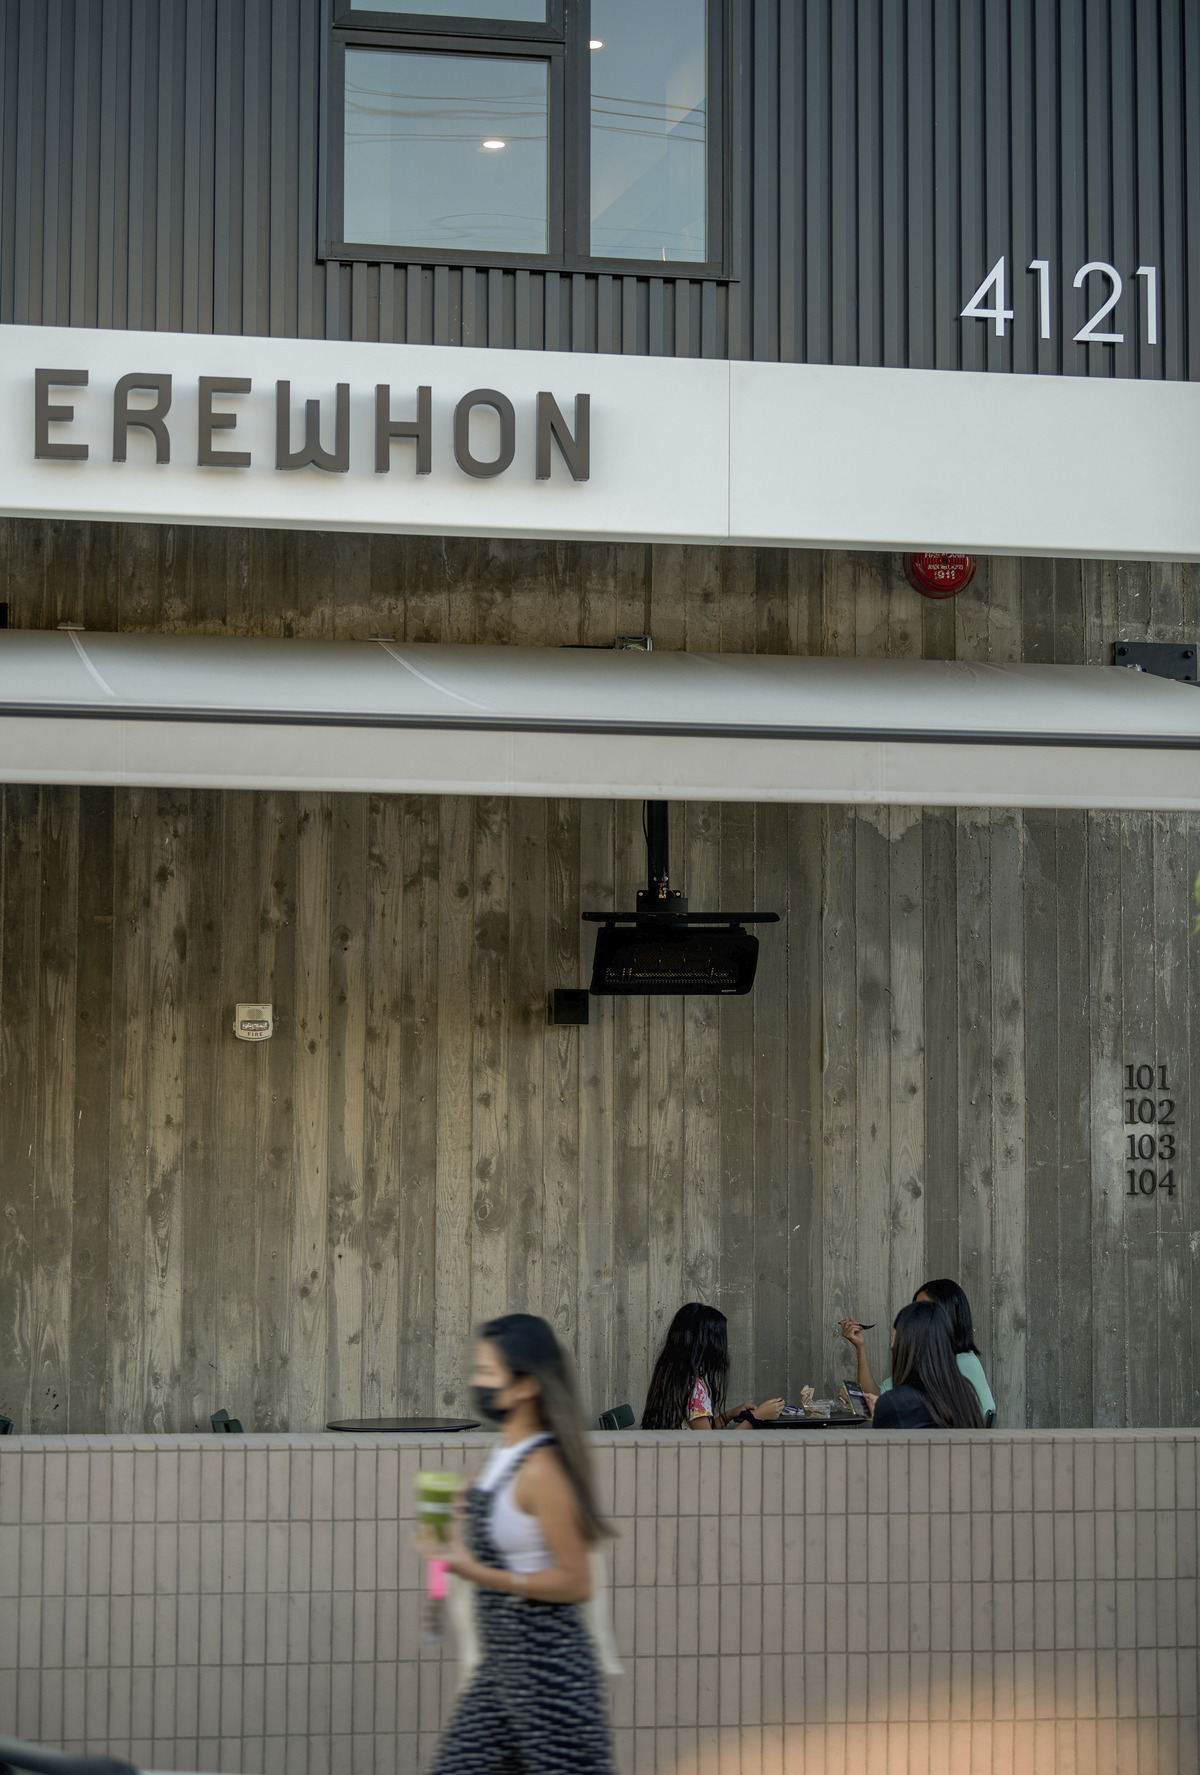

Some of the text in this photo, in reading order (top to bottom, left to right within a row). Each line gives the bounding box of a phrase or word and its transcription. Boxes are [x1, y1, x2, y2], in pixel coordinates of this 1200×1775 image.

[960, 255, 1157, 345] 4121
[34, 368, 591, 482] EREWHON
[1124, 1064, 1171, 1091] 101
[1124, 1097, 1176, 1125] 102
[1126, 1134, 1176, 1160] 103
[1126, 1168, 1177, 1196] 104
